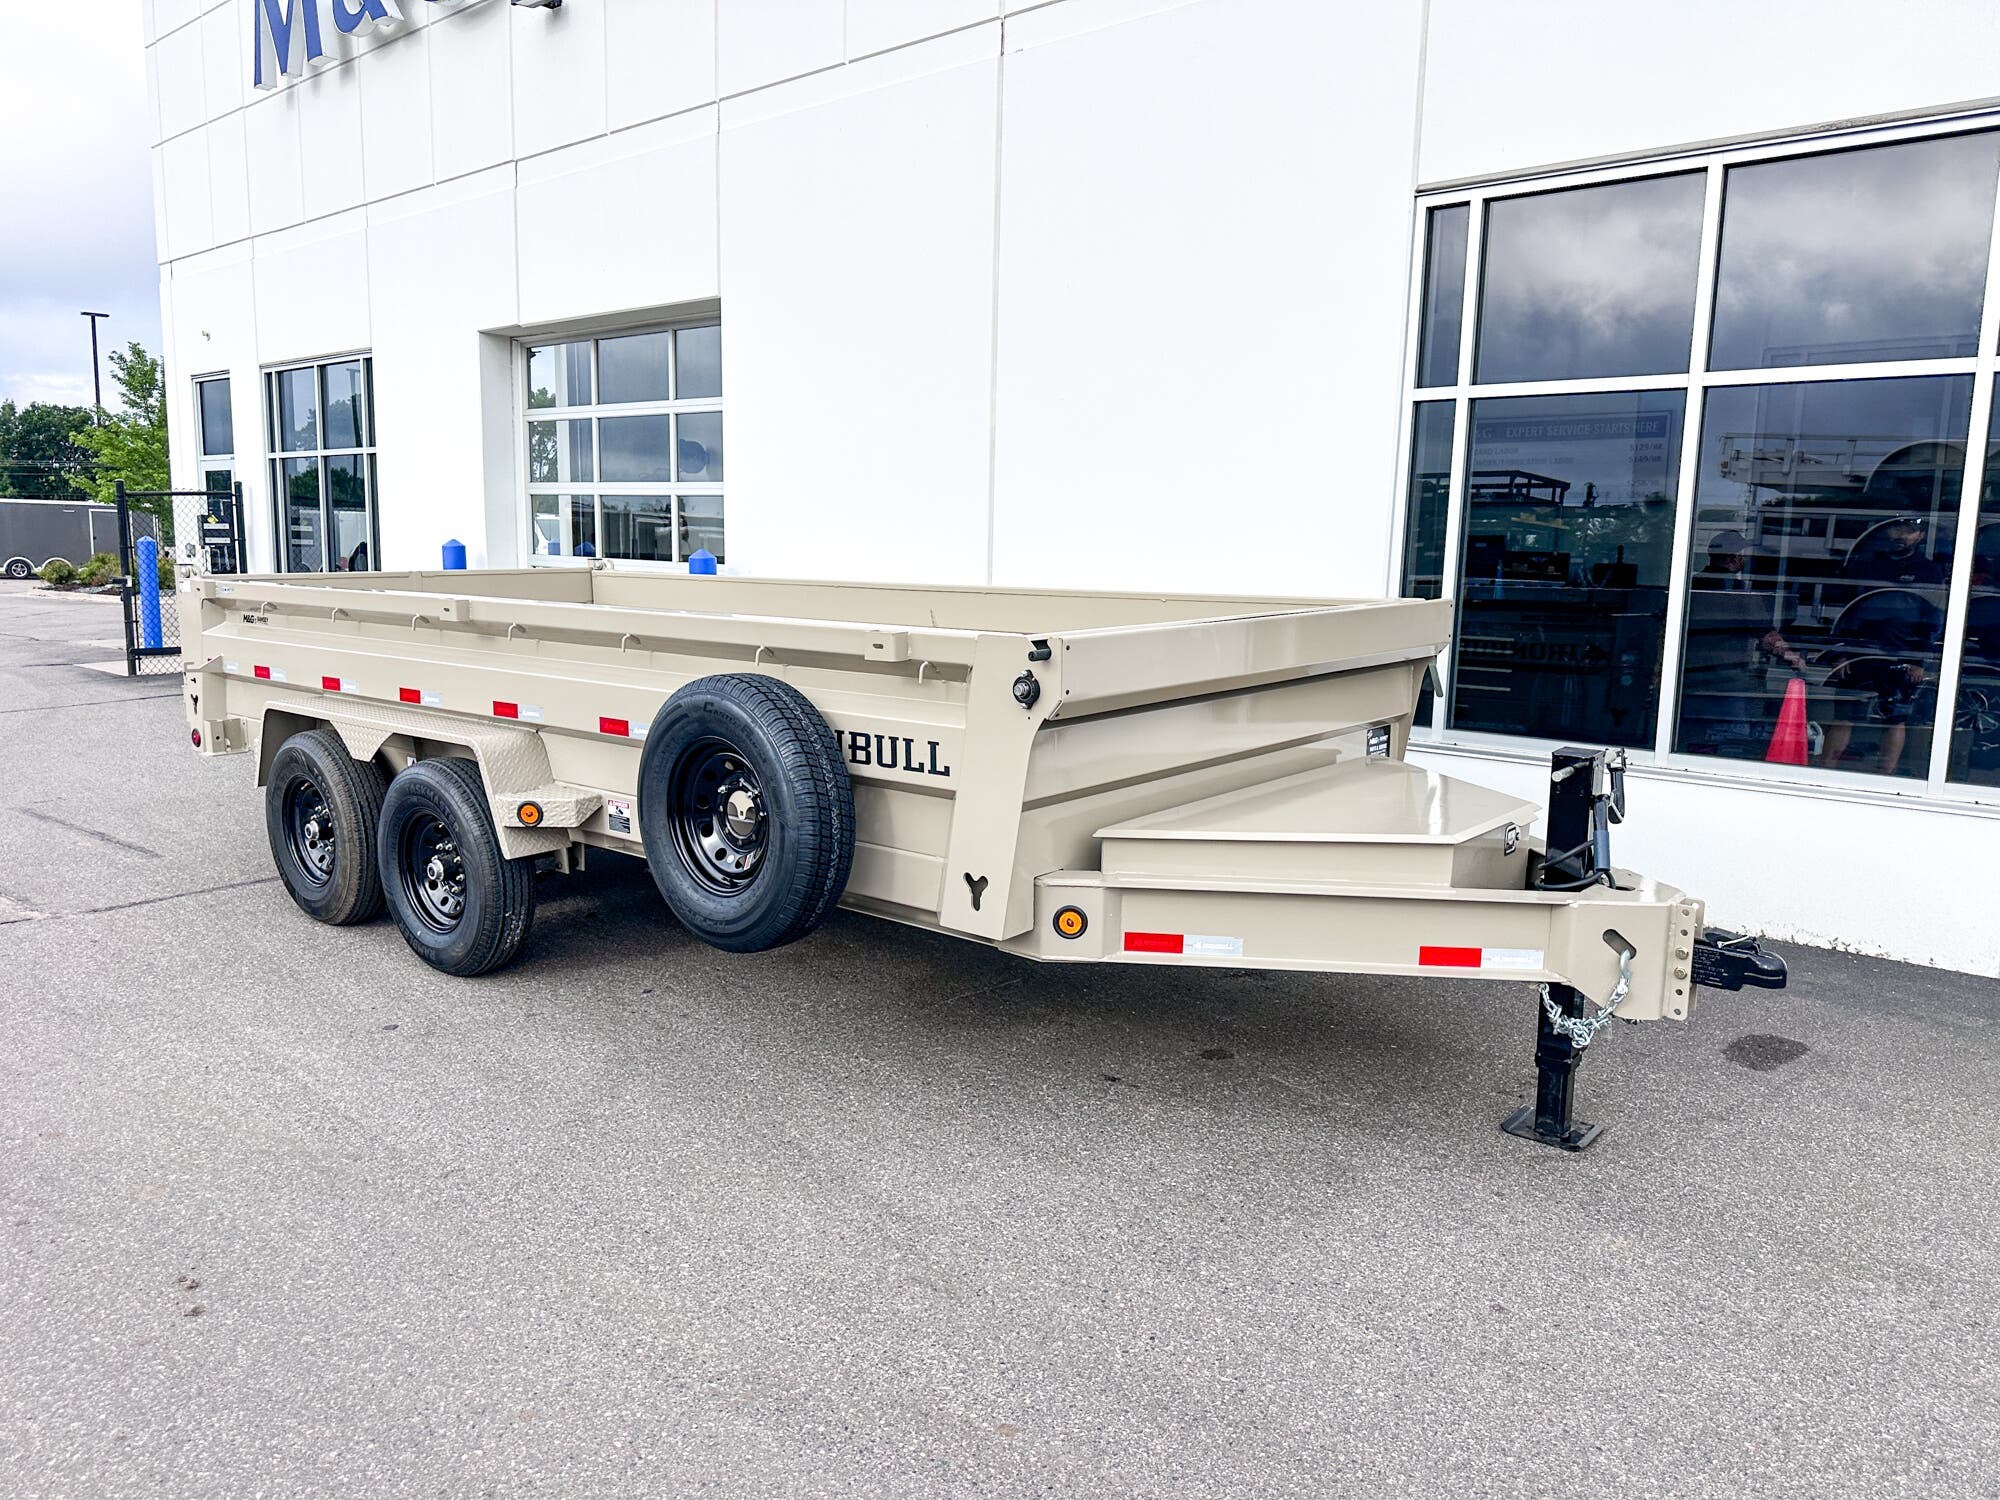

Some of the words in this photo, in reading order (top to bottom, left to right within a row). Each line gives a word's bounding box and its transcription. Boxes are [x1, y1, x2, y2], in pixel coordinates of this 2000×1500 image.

[1505, 426, 1545, 438] EXPERT
[1547, 424, 1591, 437] SERVICE
[1592, 422, 1631, 434] STARTS
[1632, 420, 1660, 432] HERE
